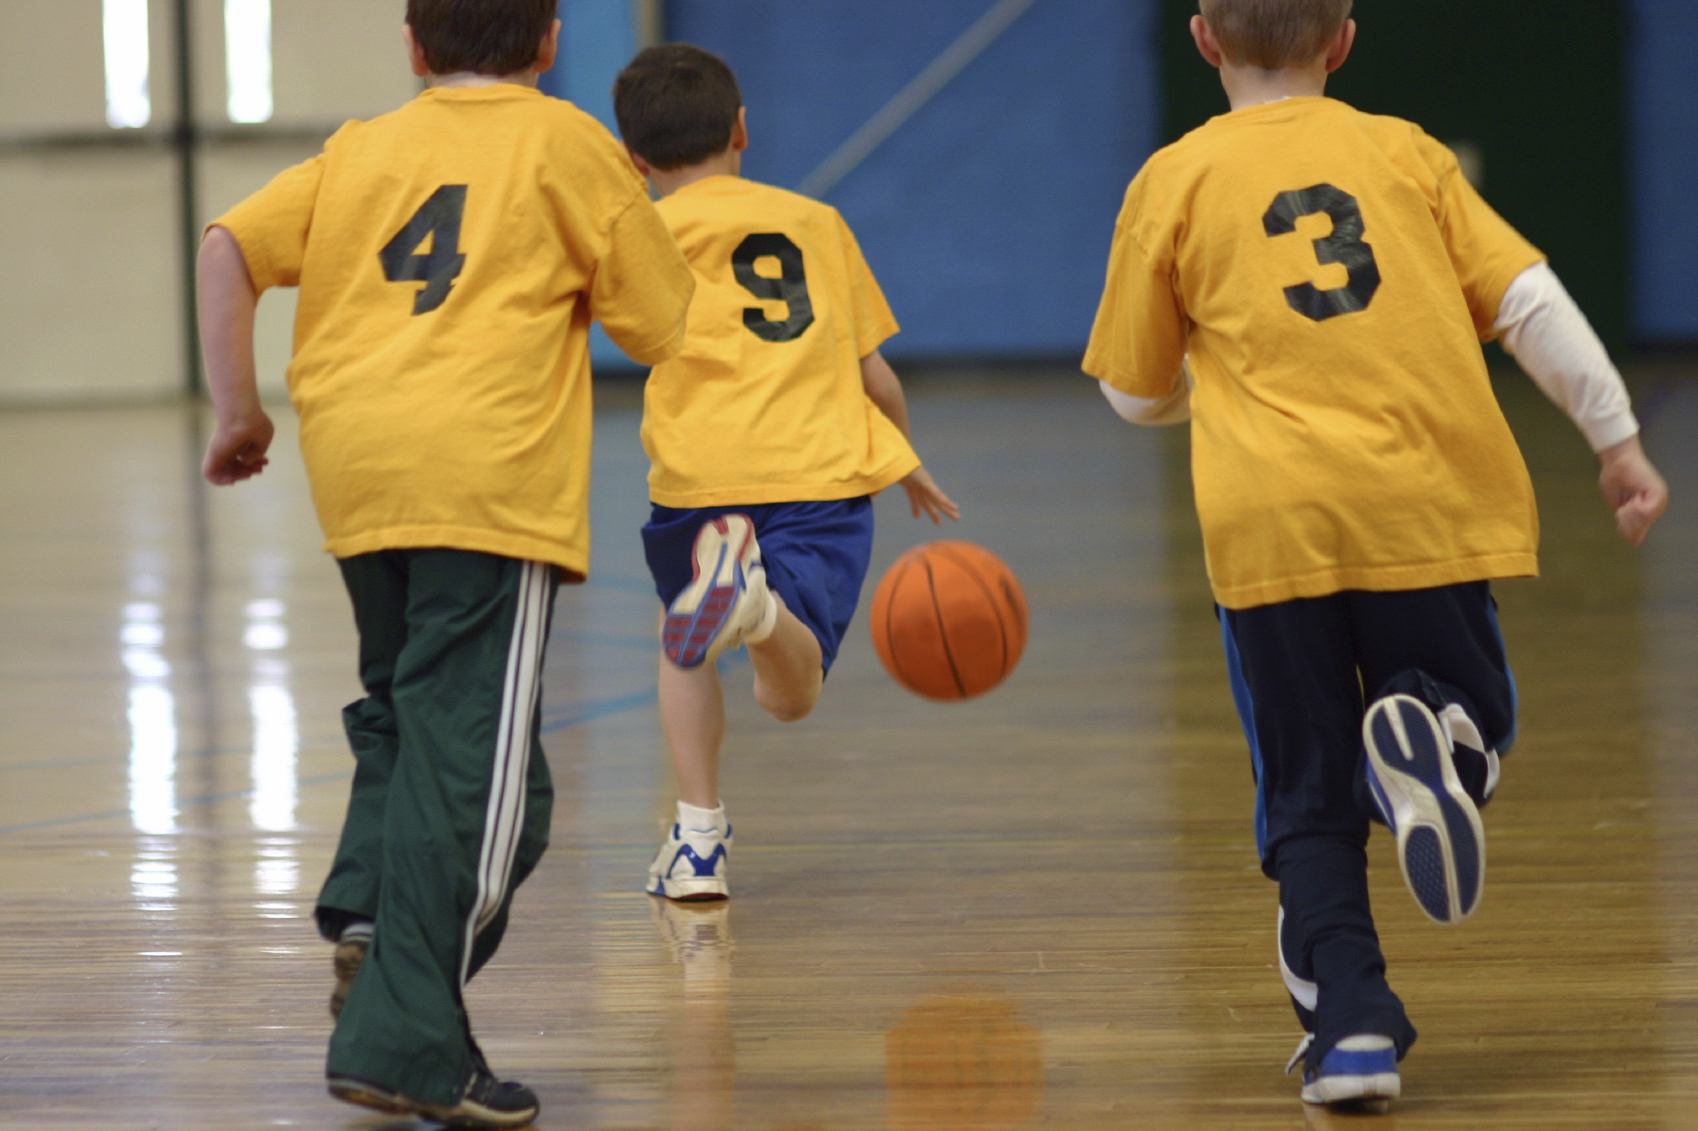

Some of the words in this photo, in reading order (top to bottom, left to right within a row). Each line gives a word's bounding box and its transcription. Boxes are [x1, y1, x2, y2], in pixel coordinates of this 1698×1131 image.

[379, 184, 467, 315] 4
[731, 232, 814, 343] 9
[1262, 182, 1381, 321] 3
